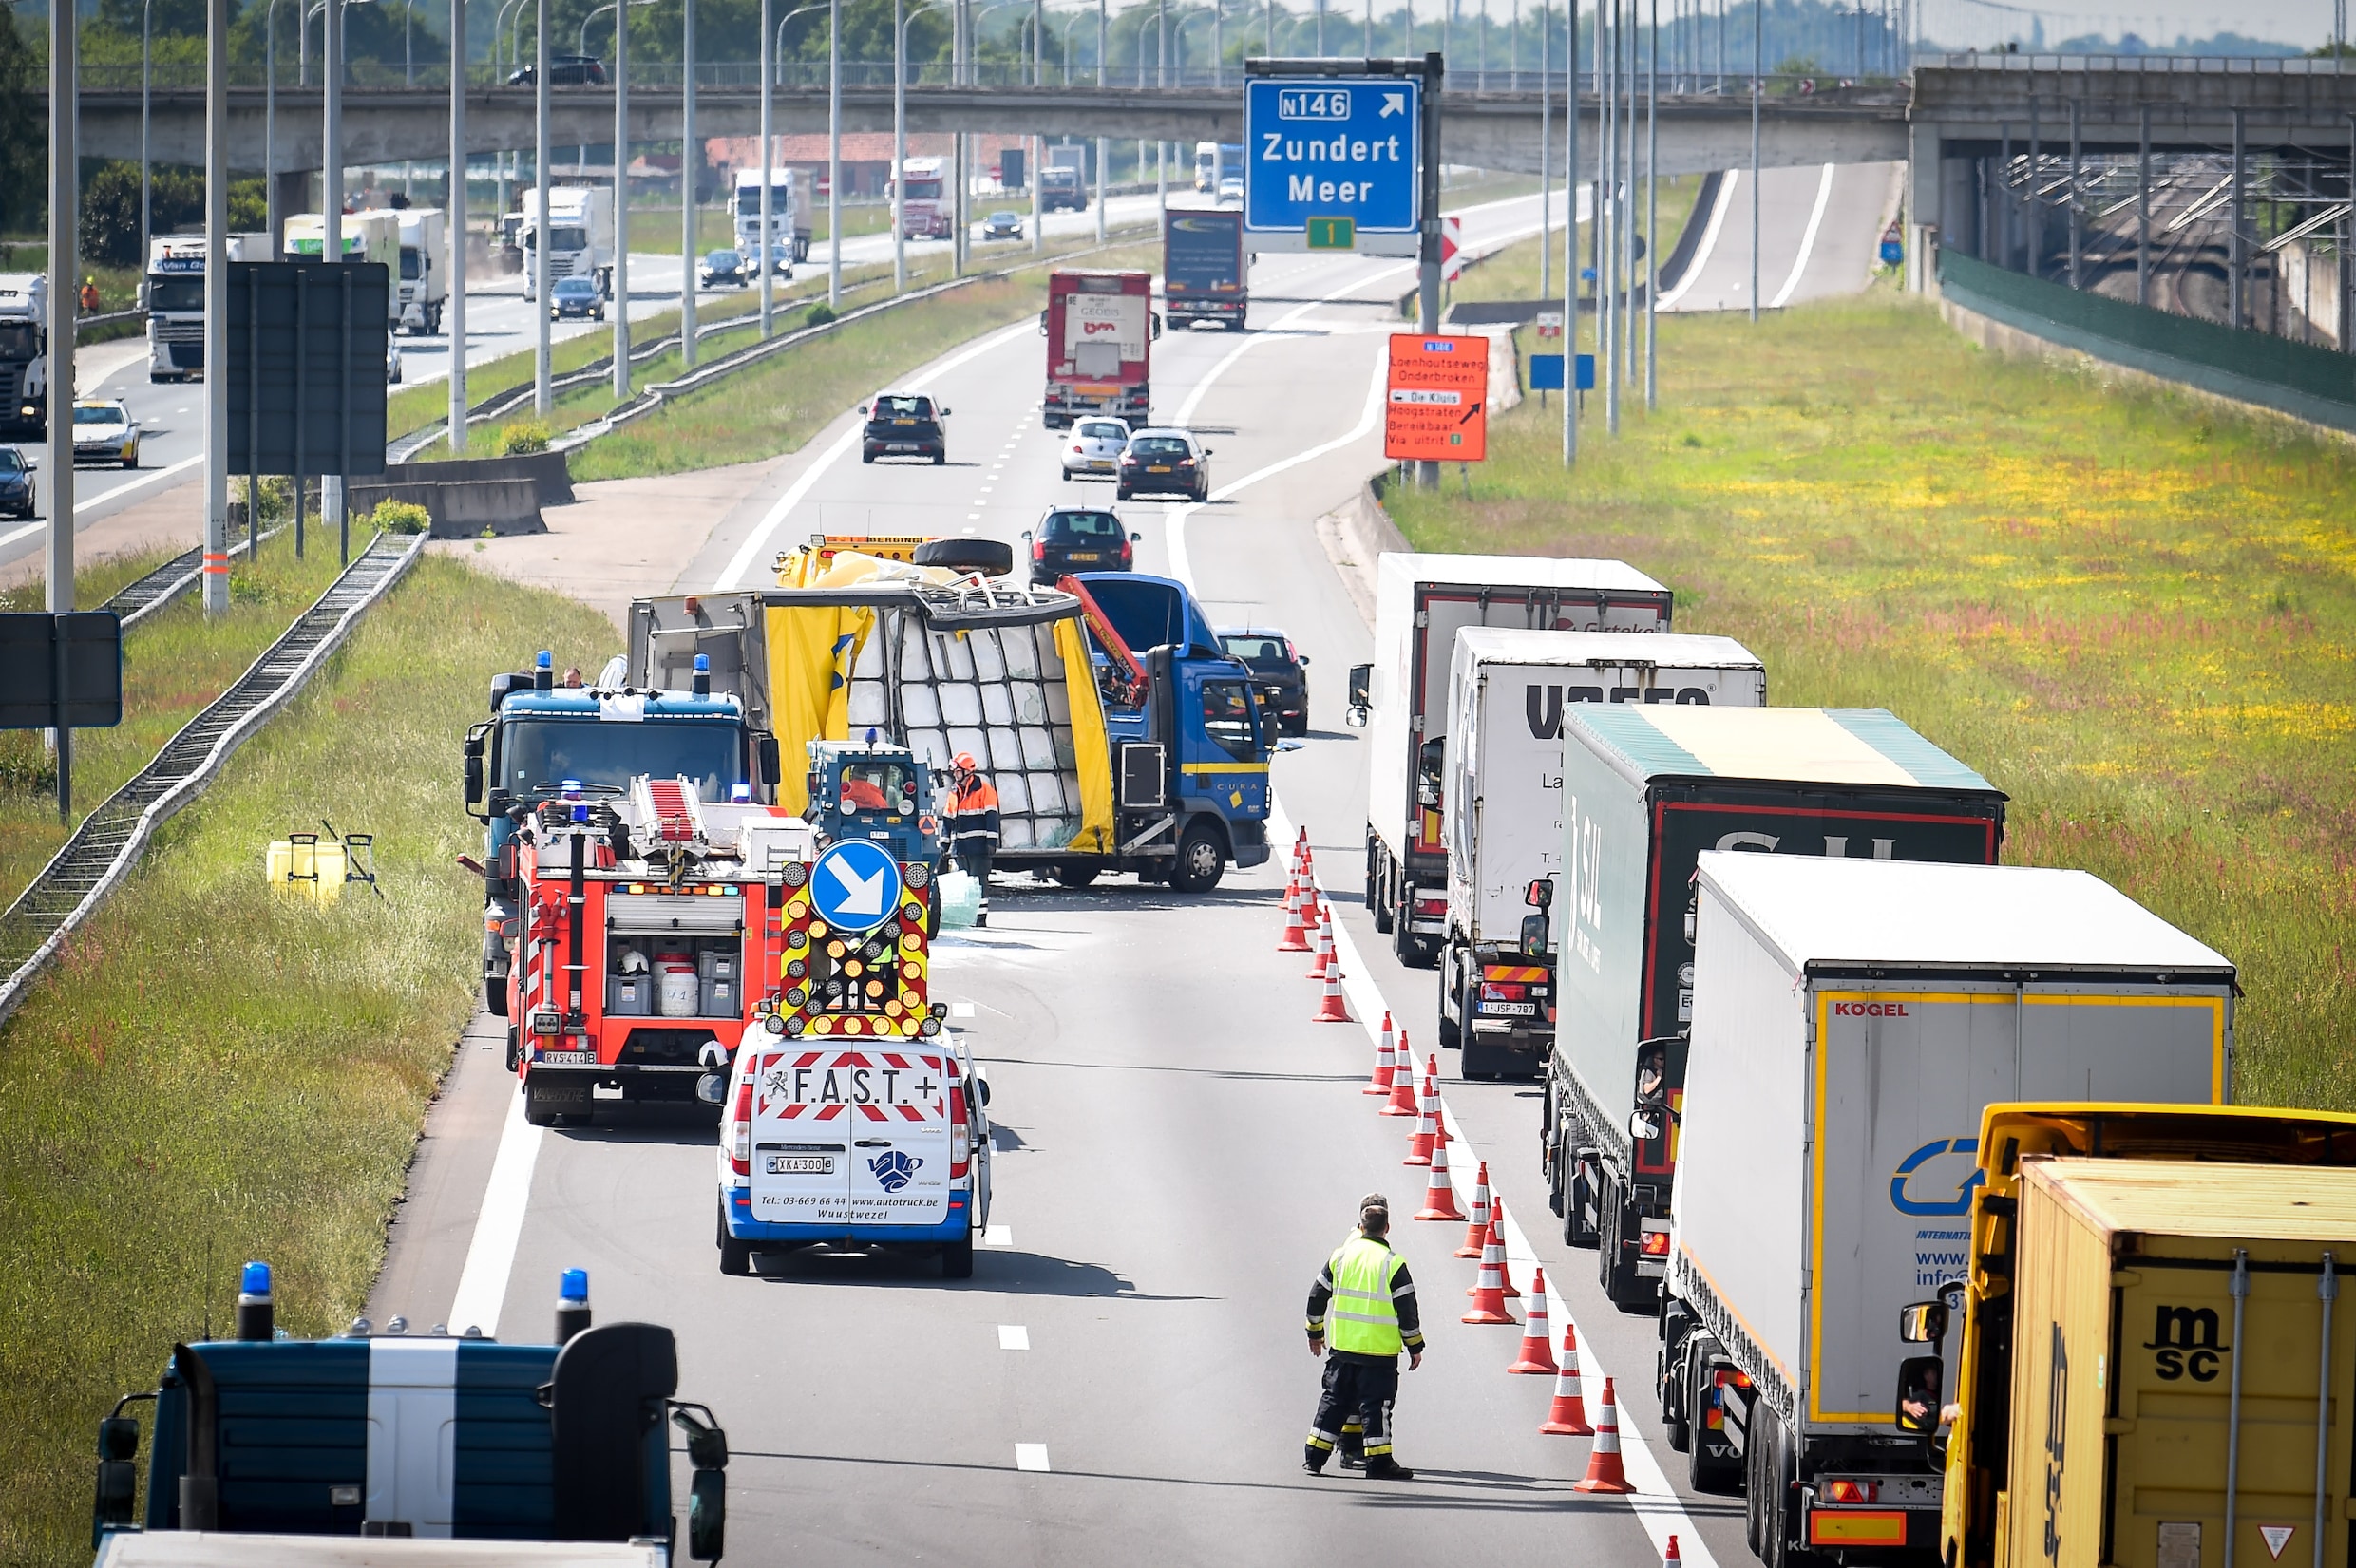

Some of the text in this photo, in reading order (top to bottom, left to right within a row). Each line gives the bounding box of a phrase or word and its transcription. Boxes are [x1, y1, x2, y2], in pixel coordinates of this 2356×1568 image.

[1283, 94, 1347, 116] N146
[1262, 133, 1400, 161] Zundert
[1288, 174, 1374, 203] Meer
[1326, 222, 1335, 245] 1
[1398, 370, 1475, 383] Onderbroken
[1388, 406, 1462, 417] Hoogstraten
[1389, 421, 1454, 431] Bereikbaar
[1835, 1002, 1909, 1016] KÖGEL
[761, 1196, 939, 1207] Tel.: 03-669 66 44 www.autotruck.be
[817, 1209, 888, 1219] Wuustwezel
[1916, 1253, 1969, 1265] www.
